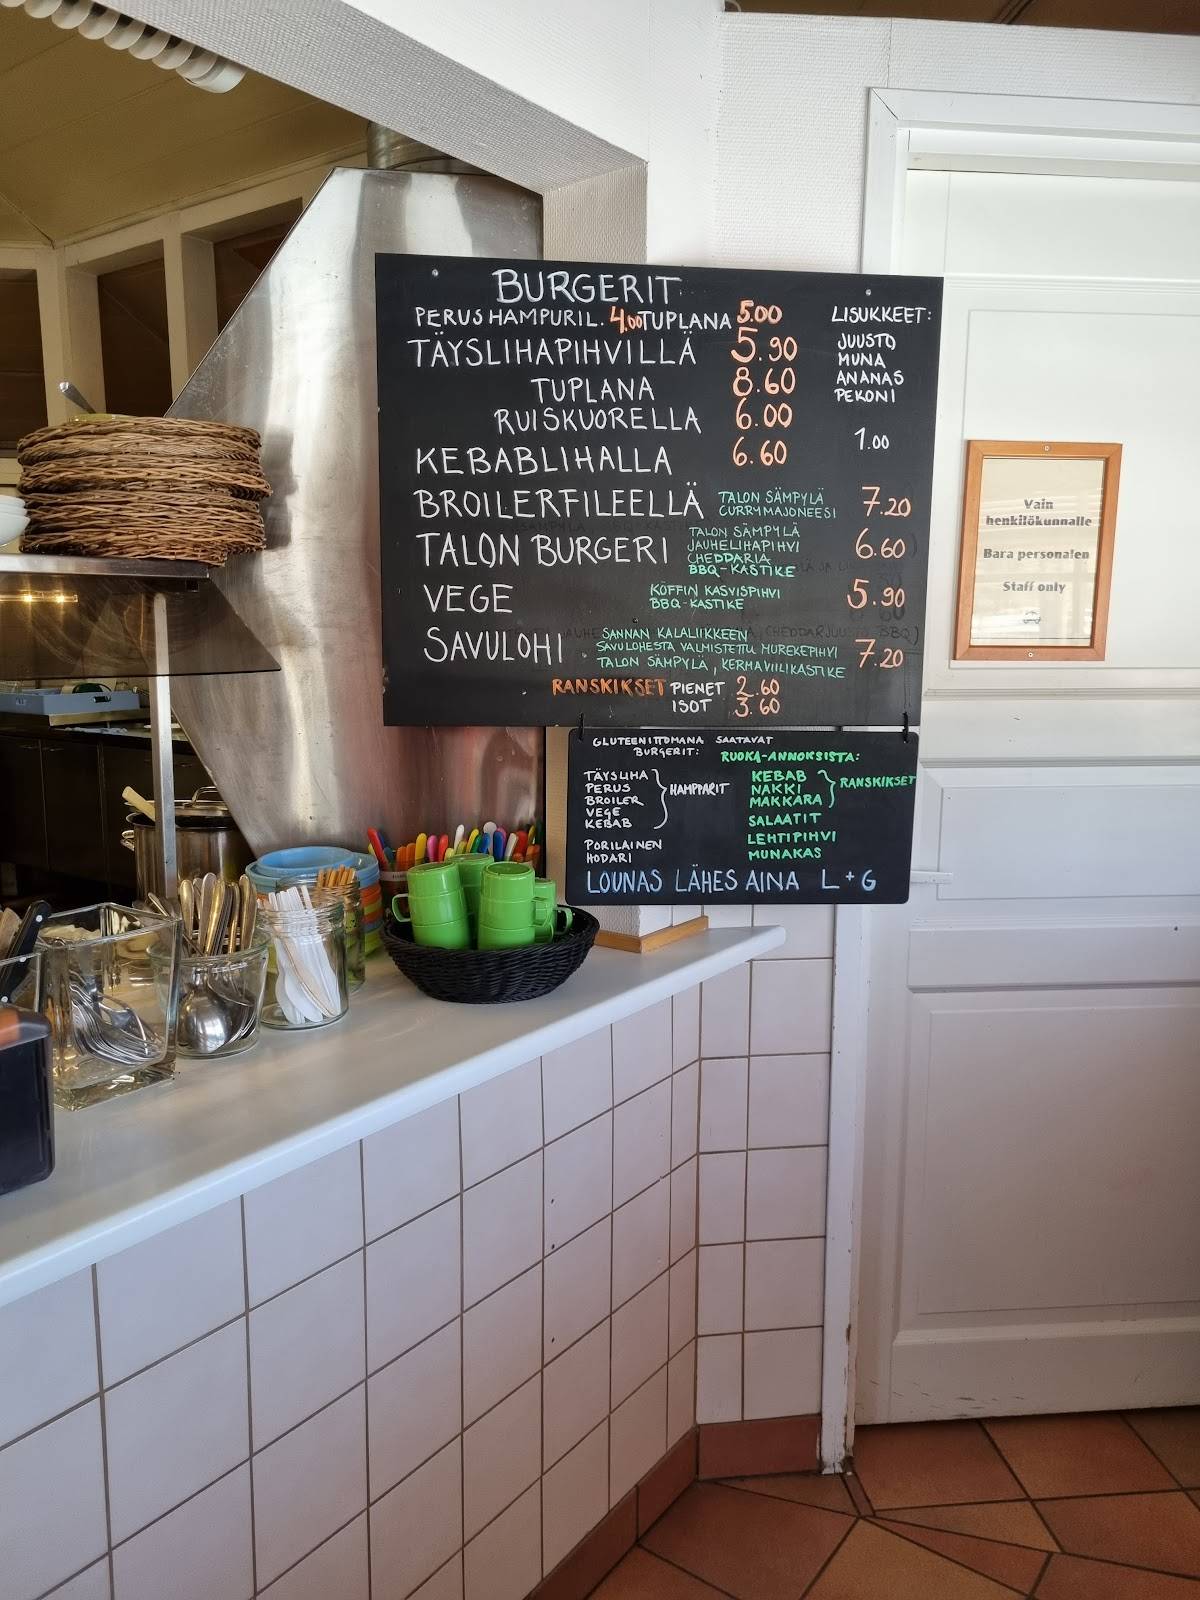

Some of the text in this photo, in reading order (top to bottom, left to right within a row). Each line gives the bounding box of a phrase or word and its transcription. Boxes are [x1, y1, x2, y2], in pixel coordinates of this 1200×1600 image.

[492, 269, 682, 304] BURGERIT
[415, 300, 783, 334] PERUS HAMPURIL. 4.00 TUPLANA 5.00
[831, 305, 932, 324] LISUKKEET:
[407, 327, 798, 368] TÄYSLIHAPIHVILLÄ 5.90
[837, 332, 896, 351] JUUSTO
[838, 352, 886, 369] MUNA
[530, 366, 797, 404] TUPLANA 8.60
[836, 369, 905, 387] ANANAS
[834, 388, 896, 403] PEKONI
[494, 397, 793, 436] RUISKUORELLA 6.00
[854, 427, 890, 451] 1.00
[416, 436, 787, 476] KEBABLIHALLA 6.60
[413, 481, 912, 520] BROILERFILEELLÄ 7.20
[718, 487, 824, 506] TALON SÄMPYLÄ
[1024, 498, 1054, 510] Vain
[986, 514, 1093, 527] henkilökunnalle
[688, 526, 728, 539] TALON
[733, 522, 801, 539] SÄMPYLÄ
[416, 532, 668, 569] TALON BURGERI
[687, 538, 801, 553] JAUHELIHAPIHVI
[855, 527, 906, 560] 6.60
[687, 552, 771, 566] CHEDDARIA
[983, 548, 1091, 561] Bara personalen
[704, 585, 781, 600] KASVISPIHVI
[846, 577, 906, 609] 5.90
[1002, 581, 1067, 594] Staff only
[423, 583, 513, 614] VEGE
[602, 627, 650, 640] SANNAN
[657, 626, 749, 643] KALALIIKKEEN
[424, 626, 562, 665] SAVULOHI
[596, 640, 839, 659] SAVULOHESTA VALMISTETTU MUREKEPIHVI
[855, 638, 905, 669] 7.20
[597, 656, 640, 669] TALON
[722, 657, 847, 680] KERMAVIILIKASTIKE
[552, 675, 780, 697] RANSKIKSET PIENET 2.60
[671, 697, 781, 718] ISOT 3.60
[592, 736, 774, 748] GLUTEENITTOMANA SAATAVAT
[633, 747, 700, 758] BURGERIT:
[720, 750, 861, 764] RUOKA-ANNOKSISTA:
[751, 769, 808, 783] KEBAB
[839, 775, 917, 790] RANSKIKSET
[585, 782, 731, 797] PERUS HAMPPARIT
[751, 783, 801, 797] NAKKI
[584, 795, 645, 807] BROILER
[749, 794, 823, 809] MAKKARA
[585, 807, 622, 820] VEGE
[748, 812, 823, 828] SALAATIT
[585, 817, 633, 830] KEBAB
[584, 838, 663, 851] PORILAINEN
[747, 830, 837, 846] LEHTIPIHVI
[586, 852, 632, 865] HODARI
[748, 846, 823, 861] MUNAKAS
[587, 868, 663, 895] LOUNAS
[675, 863, 738, 894] LÄHES
[745, 869, 801, 893] AINA
[821, 868, 841, 890] L
[861, 868, 877, 892] G
